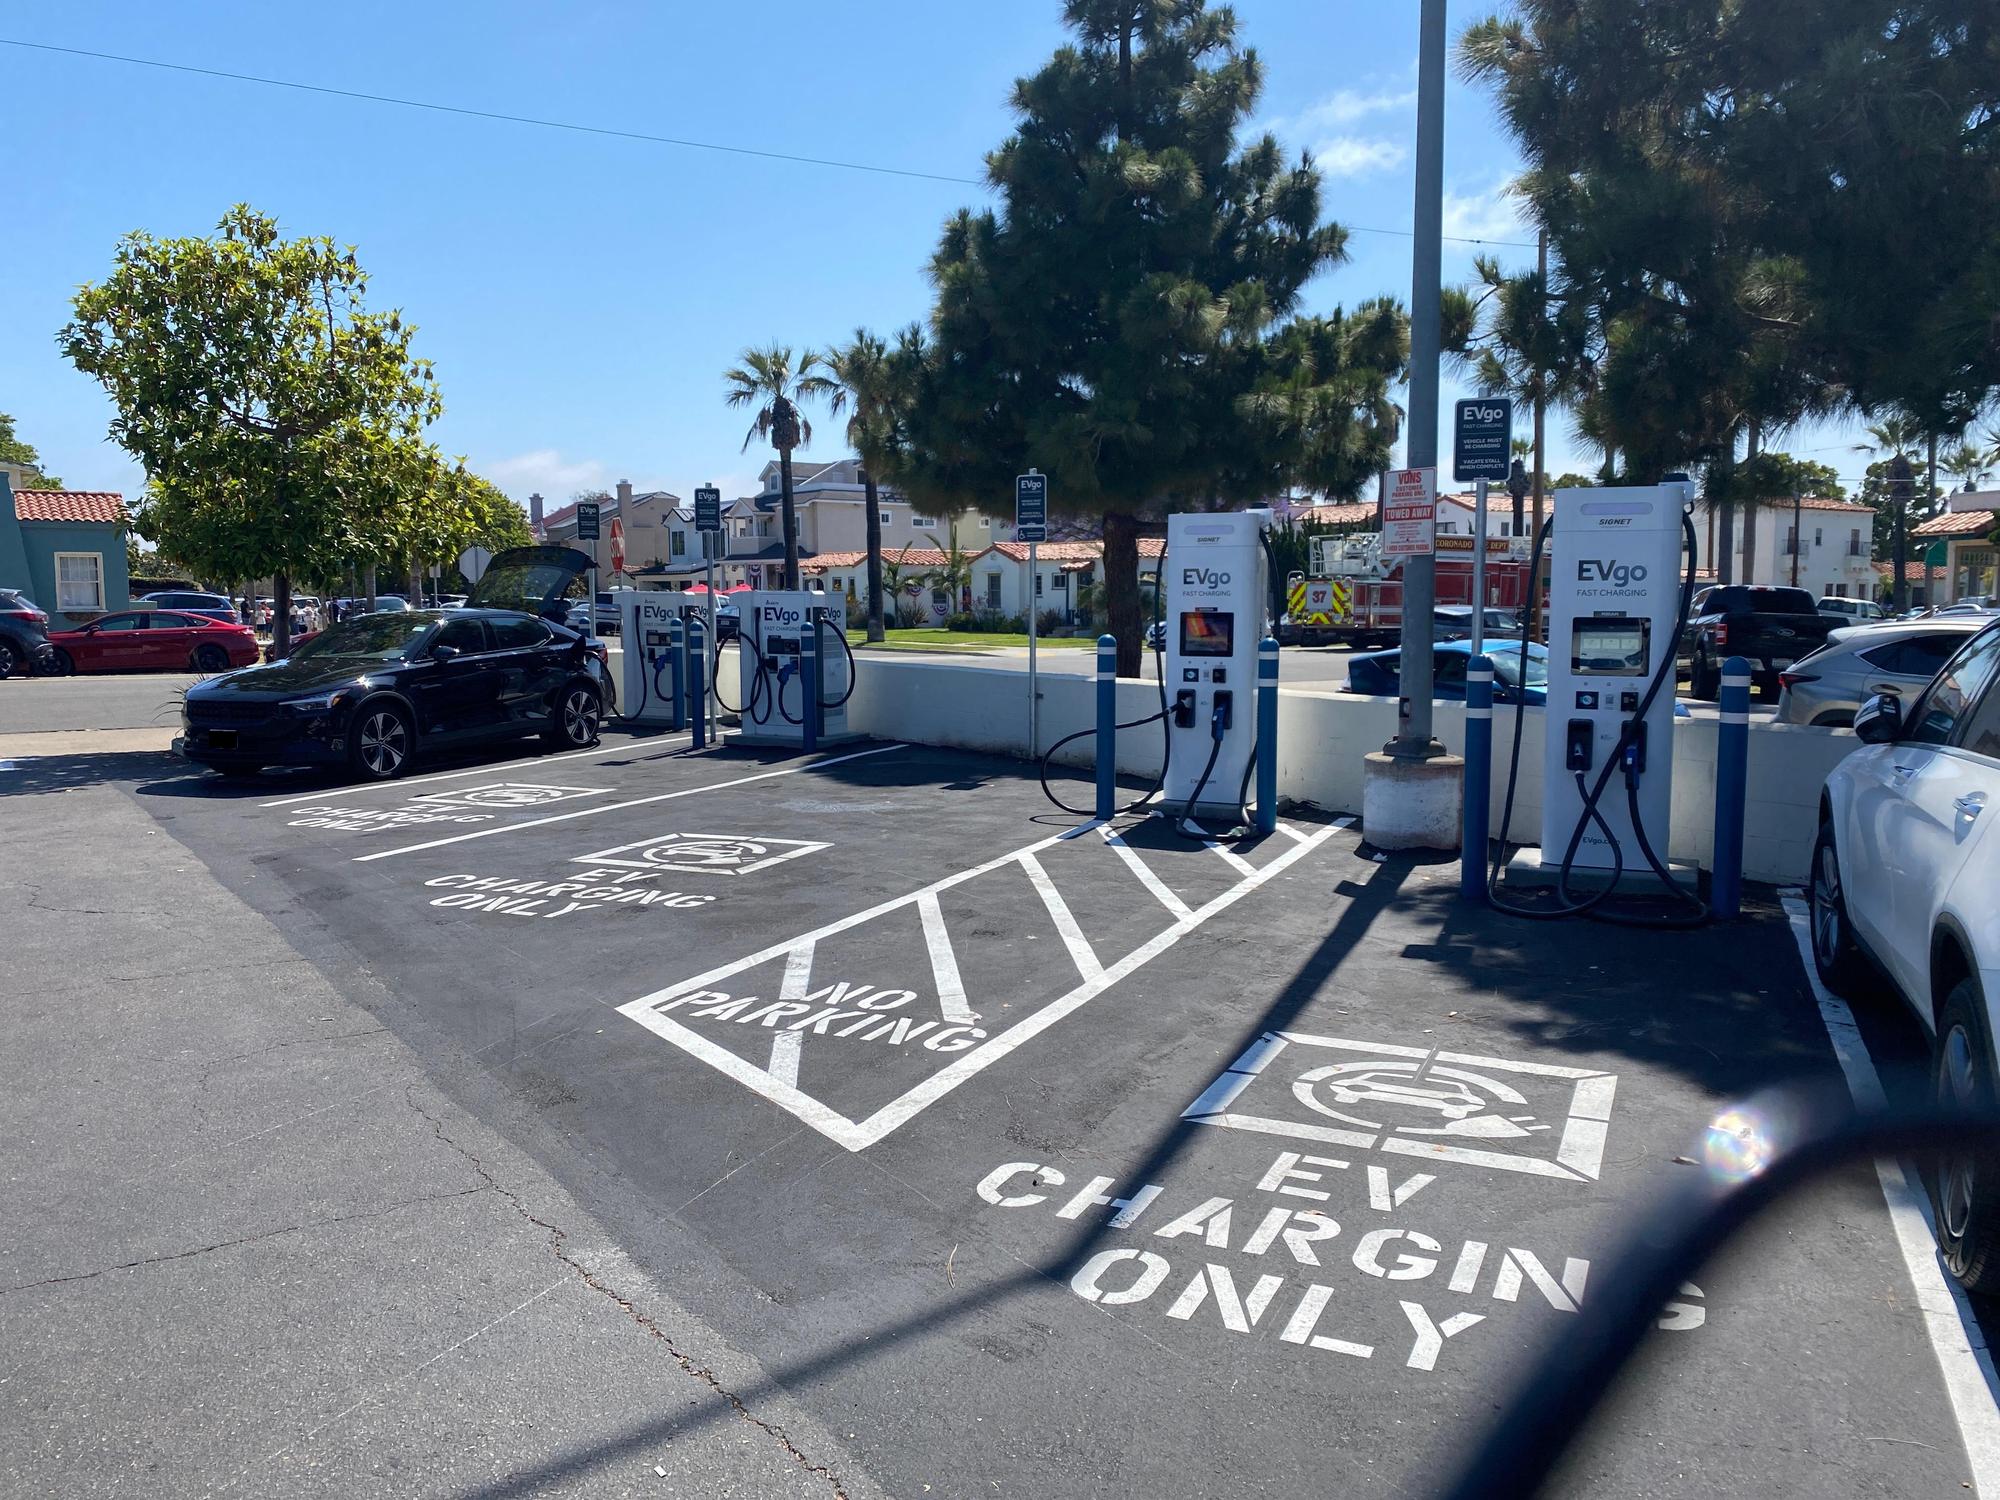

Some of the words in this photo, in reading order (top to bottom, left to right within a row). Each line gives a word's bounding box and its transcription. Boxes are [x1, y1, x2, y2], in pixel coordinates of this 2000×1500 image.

[1463, 406, 1503, 422] EVgo
[1021, 480, 1041, 490] EVgo
[1398, 472, 1422, 484] VONS
[698, 492, 716, 502] EVgo
[1386, 508, 1410, 520] TOWED
[1411, 507, 1431, 518] AWAY
[1436, 540, 1472, 548] CORONADO
[1183, 568, 1231, 589] EVgo
[1578, 559, 1647, 587] EVgo
[1312, 590, 1327, 603] 37
[1577, 589, 1598, 597] FAST
[1599, 589, 1647, 597] CHARGING
[644, 605, 674, 621] EVgo
[764, 606, 799, 625] EVgo
[823, 606, 841, 621] EVgo
[291, 806, 495, 823] CHARGING
[287, 817, 411, 832] ONLY
[566, 868, 662, 884] EV
[424, 874, 716, 908] CHARGING
[429, 893, 603, 918] ONLY
[802, 981, 918, 1011] NO
[654, 990, 988, 1052] PARKING
[1256, 1151, 1437, 1212] EV
[1070, 1248, 1486, 1371] ONLY
